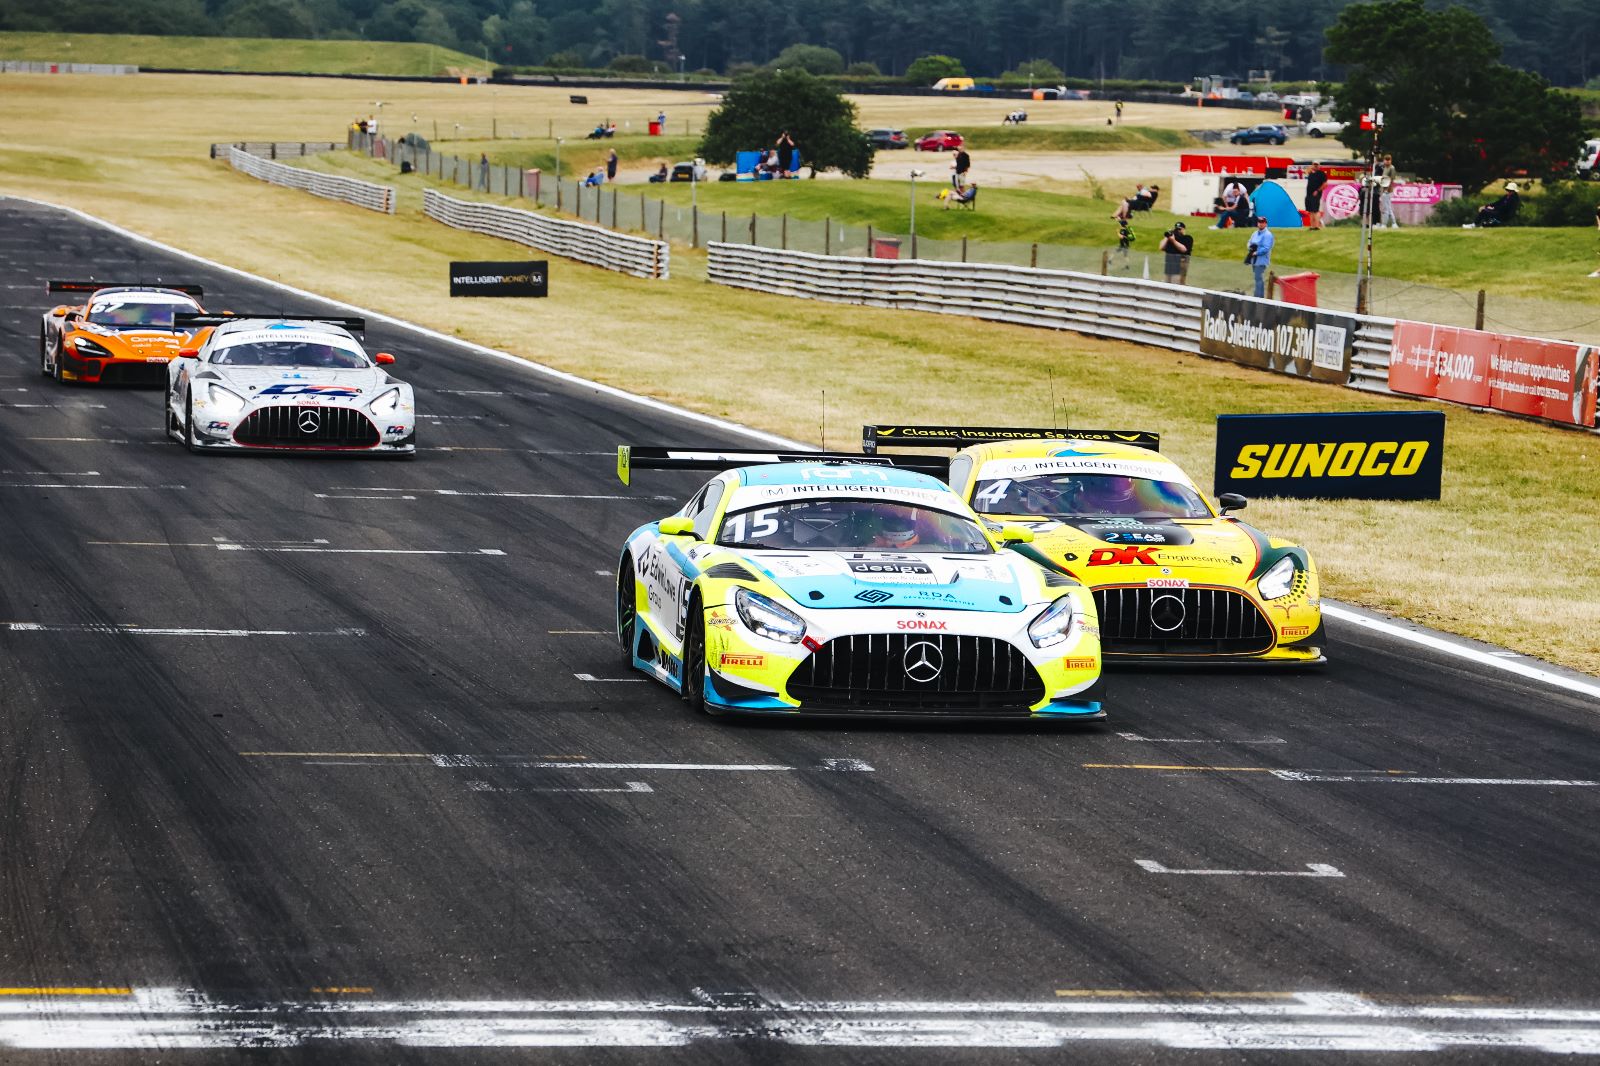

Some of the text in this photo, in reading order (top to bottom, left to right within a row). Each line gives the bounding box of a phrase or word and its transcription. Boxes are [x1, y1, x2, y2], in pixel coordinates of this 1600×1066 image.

[1204, 309, 1314, 360] Radio Snetterton 107.3FM
[1434, 351, 1475, 383] £34,000
[1530, 363, 1571, 383] opportunities
[902, 428, 1111, 440] Classic Insurance Sevices
[1230, 441, 1430, 479] SUNOCO
[975, 479, 1013, 505] 4
[725, 508, 779, 544] 15
[1087, 545, 1163, 567] DK
[1158, 553, 1234, 565] Engineering
[855, 563, 927, 574] design
[1148, 579, 1187, 587] SONAX
[919, 591, 956, 599] RDA
[897, 620, 947, 630] SONAX
[1281, 626, 1309, 636] PIRELLI
[721, 654, 763, 666] PIRELLI
[1066, 658, 1095, 669] PIRELLI
